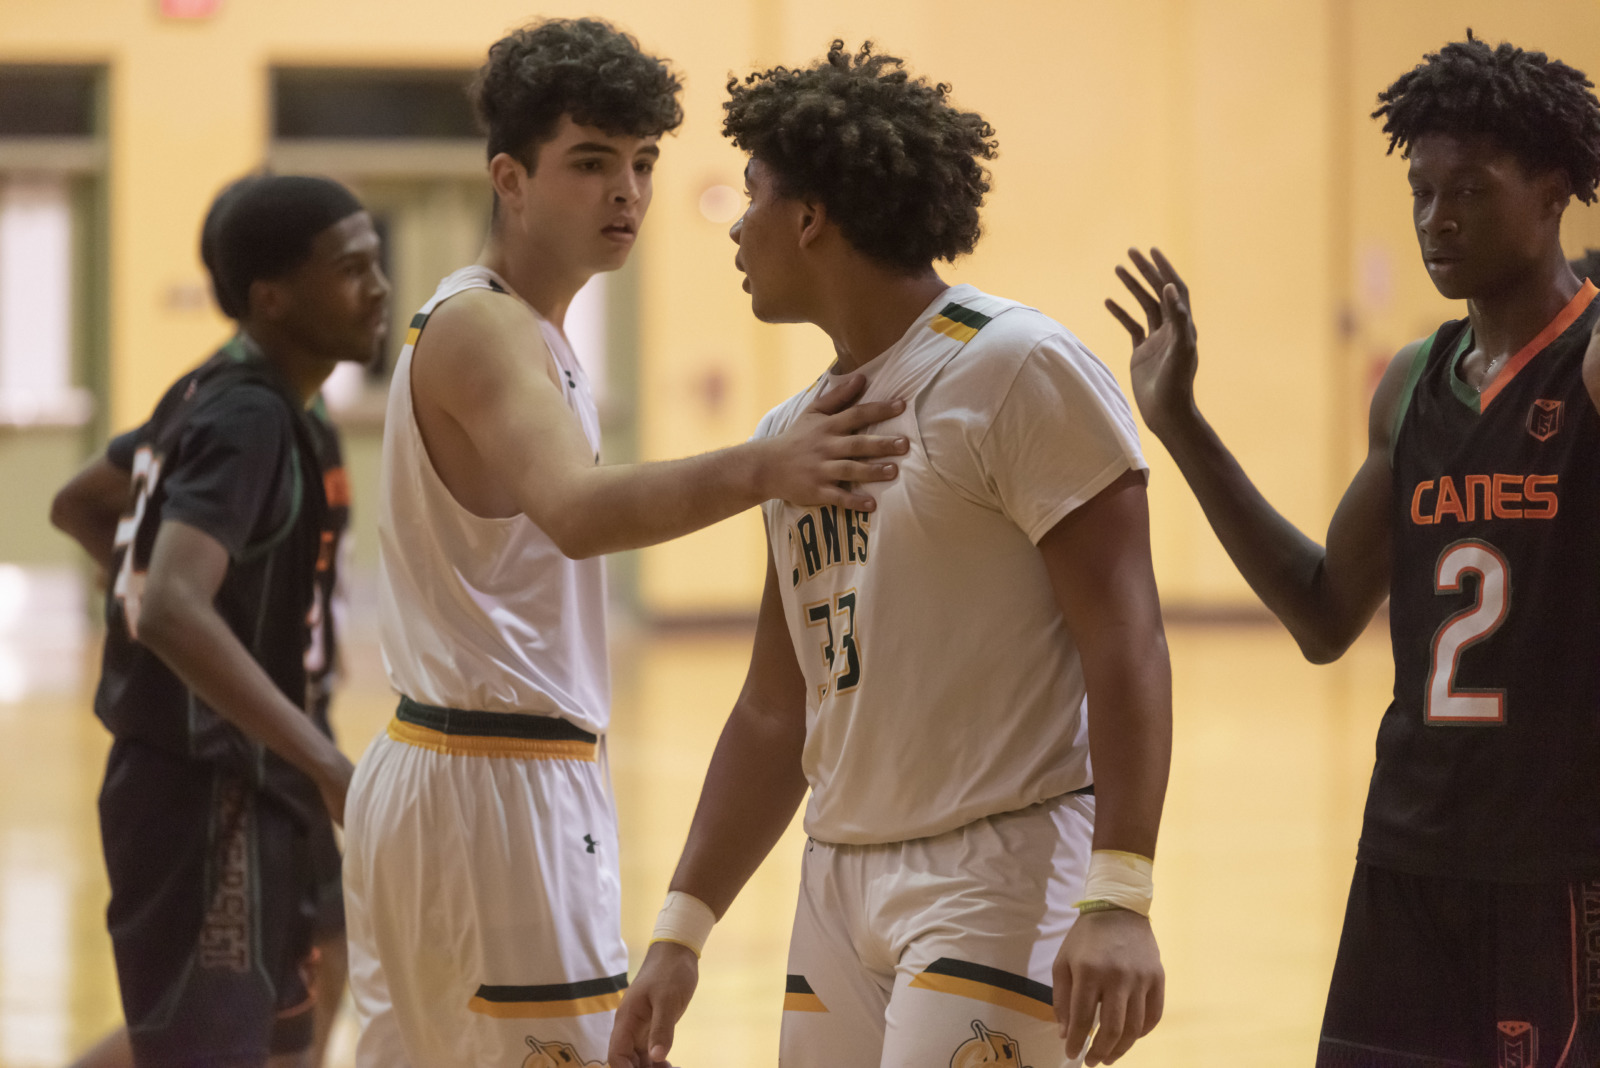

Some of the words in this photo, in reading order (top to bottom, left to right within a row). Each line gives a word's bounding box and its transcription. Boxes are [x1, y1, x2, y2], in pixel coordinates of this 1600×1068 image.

[788, 503, 871, 591] ANES
[1410, 473, 1559, 525] CANES
[803, 587, 863, 704] 33
[1424, 538, 1512, 726] 2
